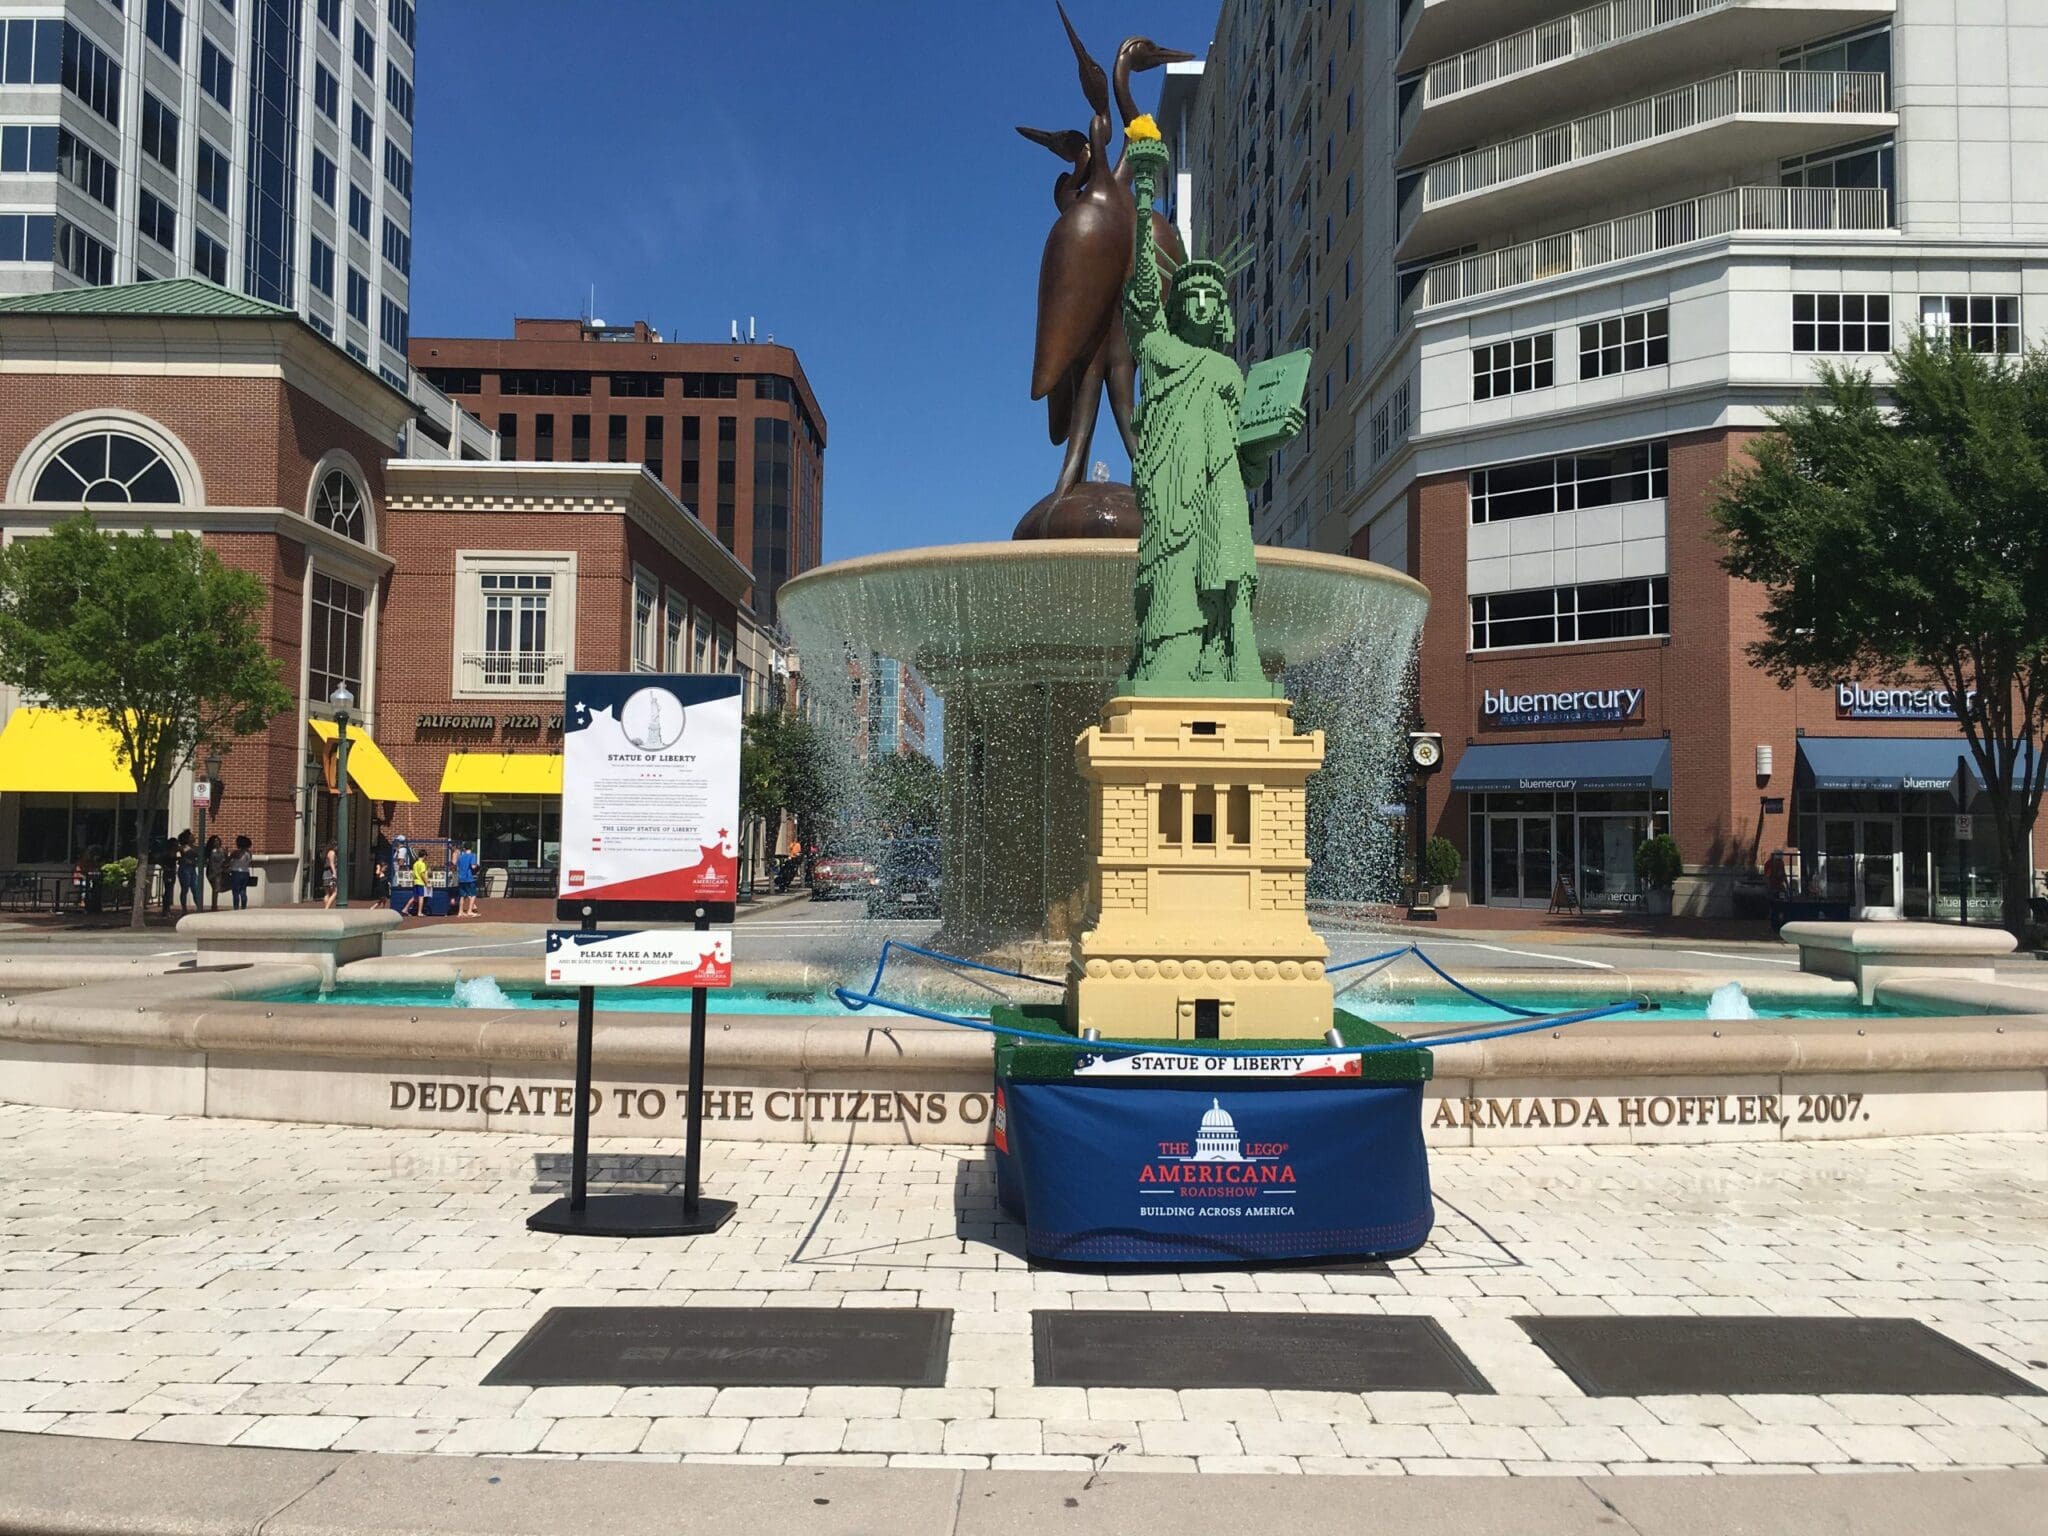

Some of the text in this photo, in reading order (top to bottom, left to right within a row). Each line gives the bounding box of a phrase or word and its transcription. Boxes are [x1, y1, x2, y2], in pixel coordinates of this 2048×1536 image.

[1484, 688, 1641, 715] bluemercury
[1839, 683, 1988, 707] bluemercr
[415, 715, 494, 729] CALIFORNIA
[502, 715, 540, 729] PIZZA
[1501, 710, 1620, 723] makeup skincare spa
[607, 754, 697, 762] STATUE OF LIBERTY
[1519, 778, 1577, 790] bluemercury
[1131, 1056, 1305, 1070] STATUE OF LIBERTY
[613, 1088, 666, 1120] TO
[764, 1091, 948, 1124] CITIZENS
[958, 1093, 995, 1125] O
[1430, 1093, 1871, 1129] ARMADA HOFFLER, 2007.
[1158, 1142, 1190, 1155] THE
[1138, 1164, 1297, 1183] AMERICANA
[1179, 1186, 1258, 1198] ROADSHOW
[1140, 1206, 1295, 1217] BUILDING ACROSS AMERICA
